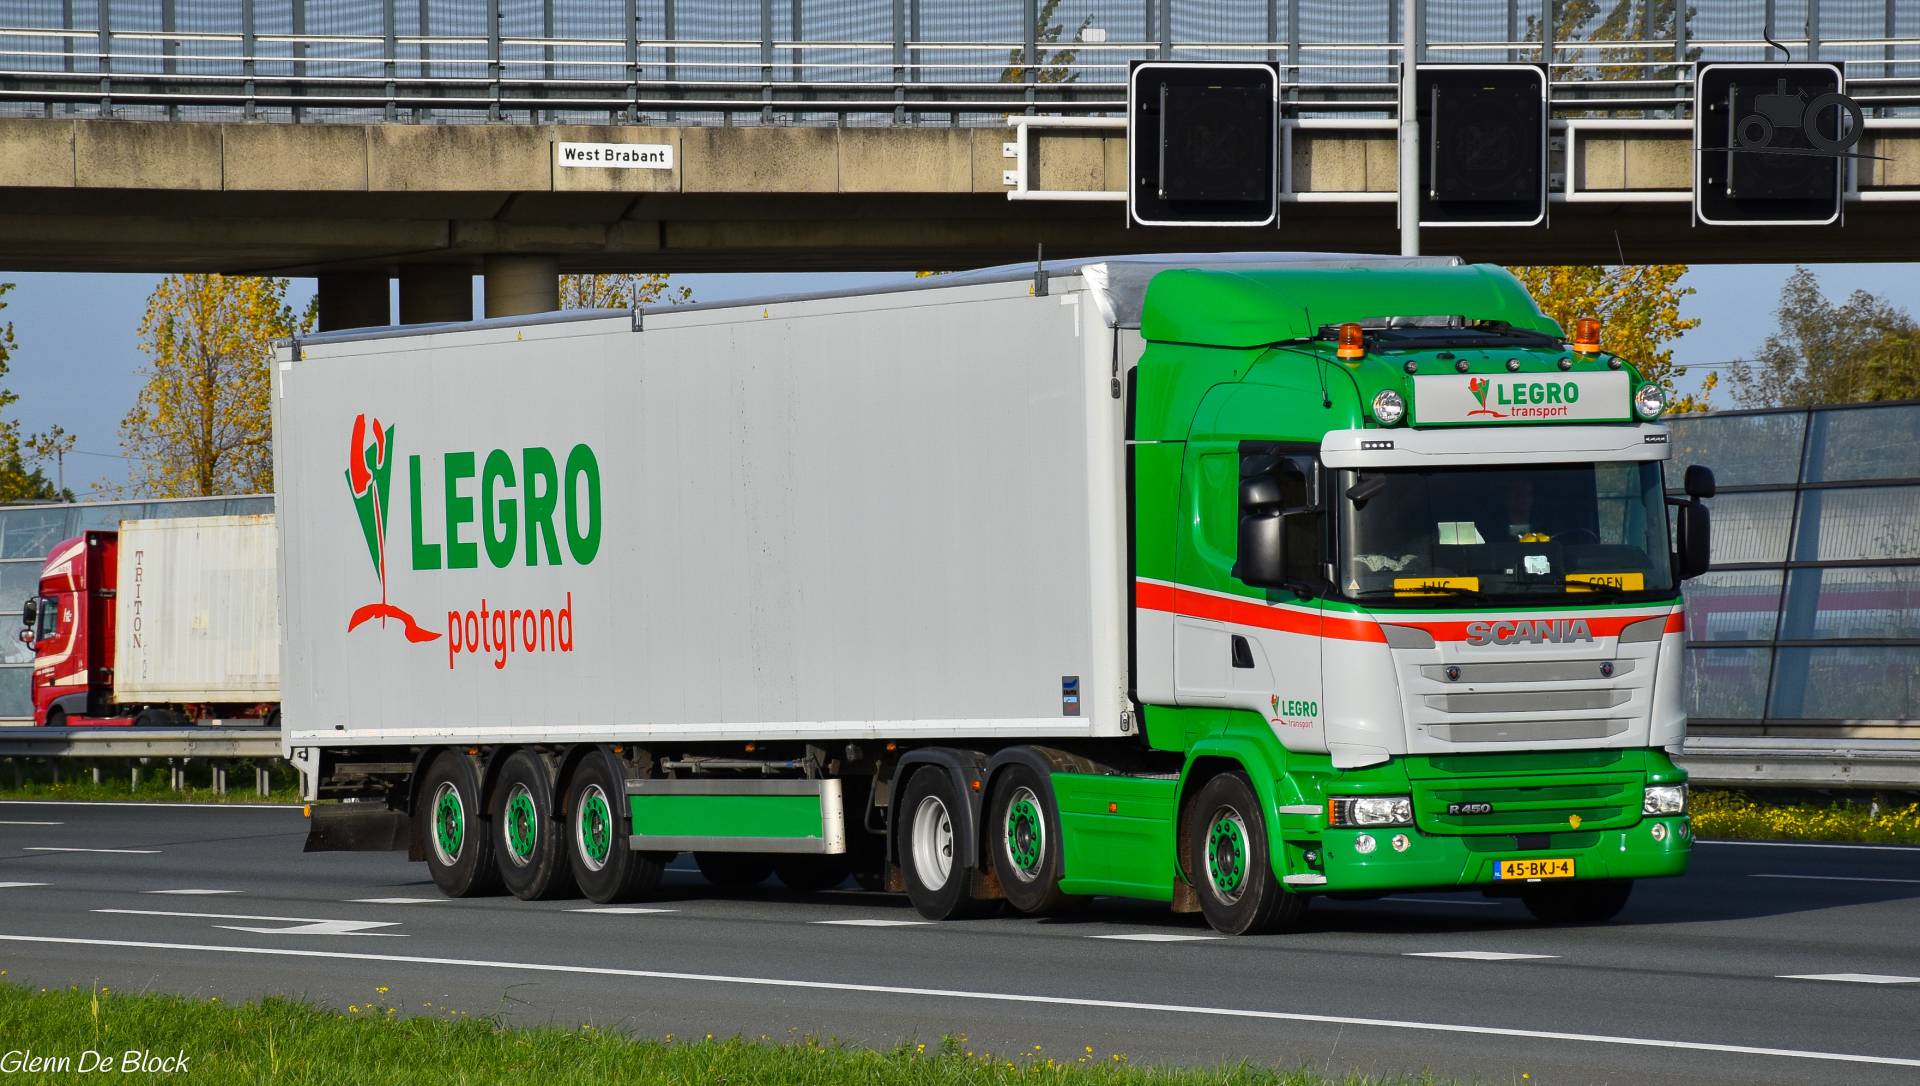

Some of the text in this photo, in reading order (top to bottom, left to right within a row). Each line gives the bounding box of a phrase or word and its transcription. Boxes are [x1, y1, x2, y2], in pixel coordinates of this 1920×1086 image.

[564, 147, 665, 163] West Brabant
[1497, 381, 1580, 405] LEGRO
[1511, 405, 1568, 419] transport
[408, 443, 602, 571] LEGRO
[133, 550, 144, 649] TRITON
[447, 591, 573, 670] potgrond
[1465, 619, 1594, 647] SCANIA
[1282, 700, 1318, 717] LEGRO
[1288, 719, 1313, 729] transport
[1449, 803, 1491, 815] R 450
[1506, 861, 1569, 876] 45-BKJ-4
